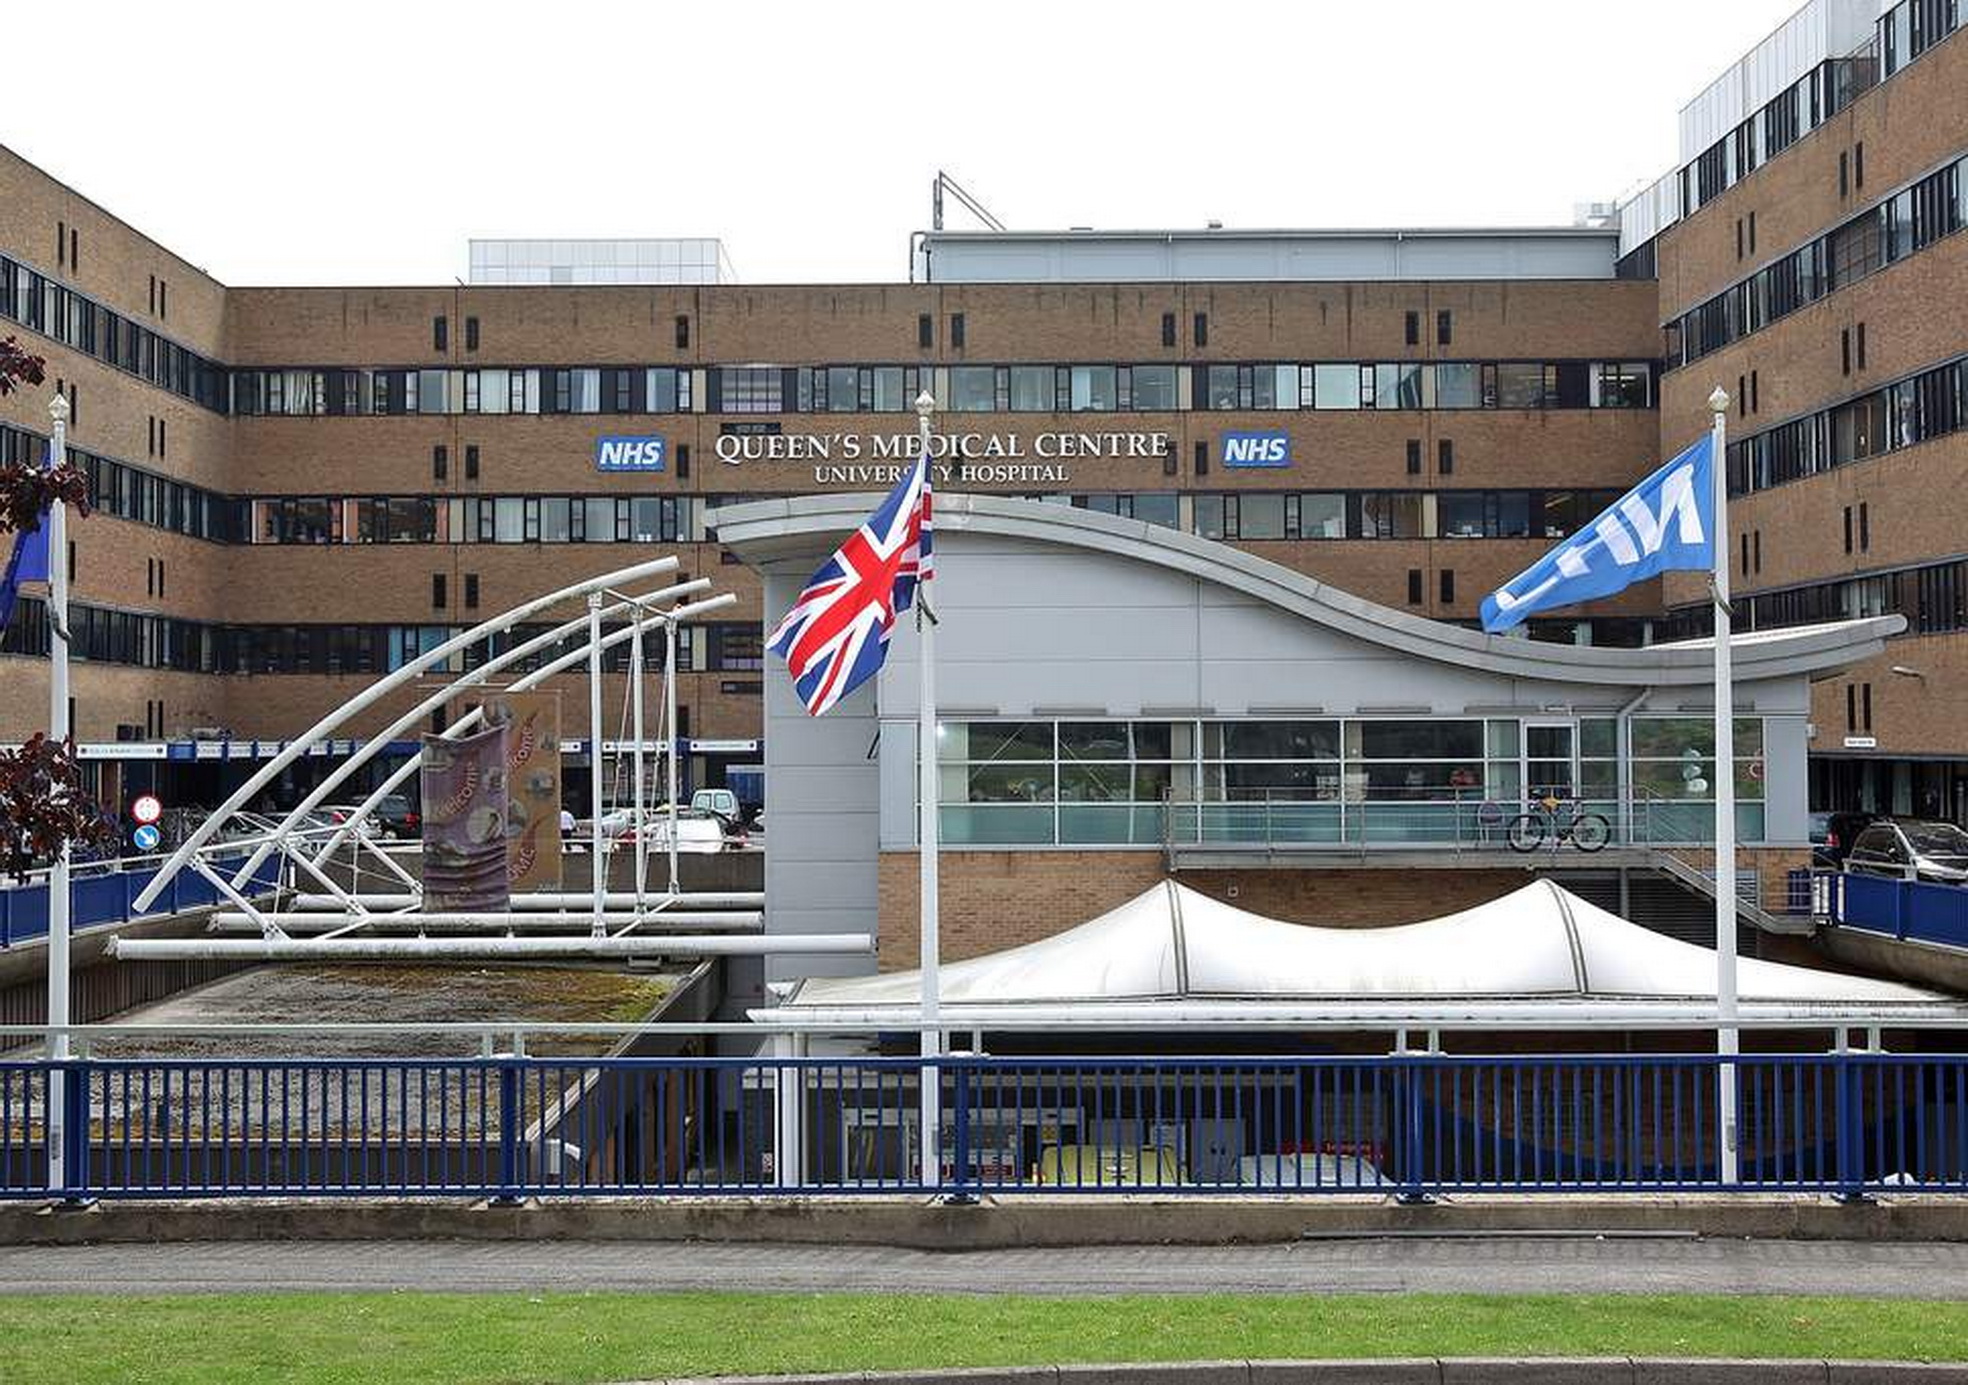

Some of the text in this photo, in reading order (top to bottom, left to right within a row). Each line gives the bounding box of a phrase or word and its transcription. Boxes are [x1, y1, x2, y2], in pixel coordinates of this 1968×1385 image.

[600, 442, 661, 465] NHS
[715, 433, 1169, 465] QUEEN'S MEDICAL CENTRE
[1225, 438, 1287, 461] NHS
[815, 464, 1069, 483] UNIVERTY HOSPITAL
